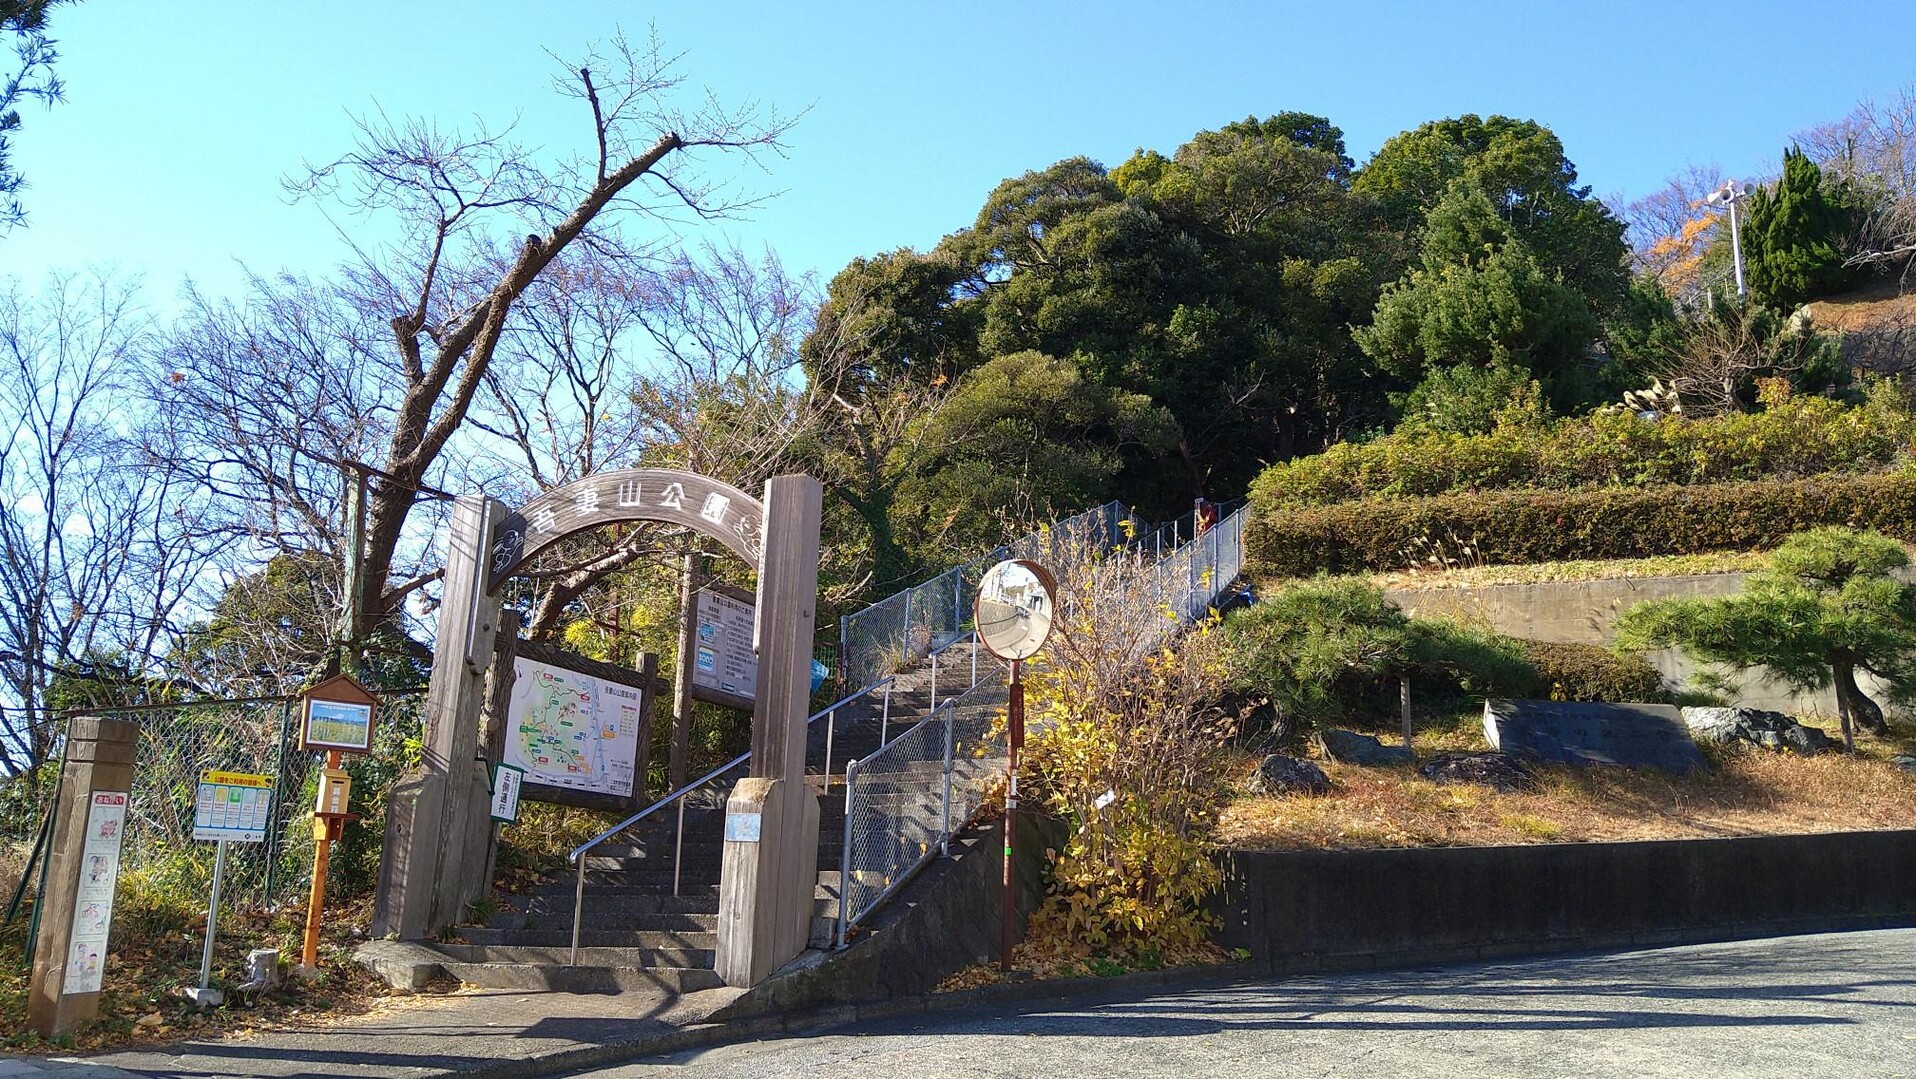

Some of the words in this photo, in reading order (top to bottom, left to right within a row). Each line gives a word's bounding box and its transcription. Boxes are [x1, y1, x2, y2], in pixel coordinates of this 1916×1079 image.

[532, 479, 731, 535] 吾妻山公園
[96, 796, 124, 804] おねがい
[498, 771, 511, 814] 左側通行
